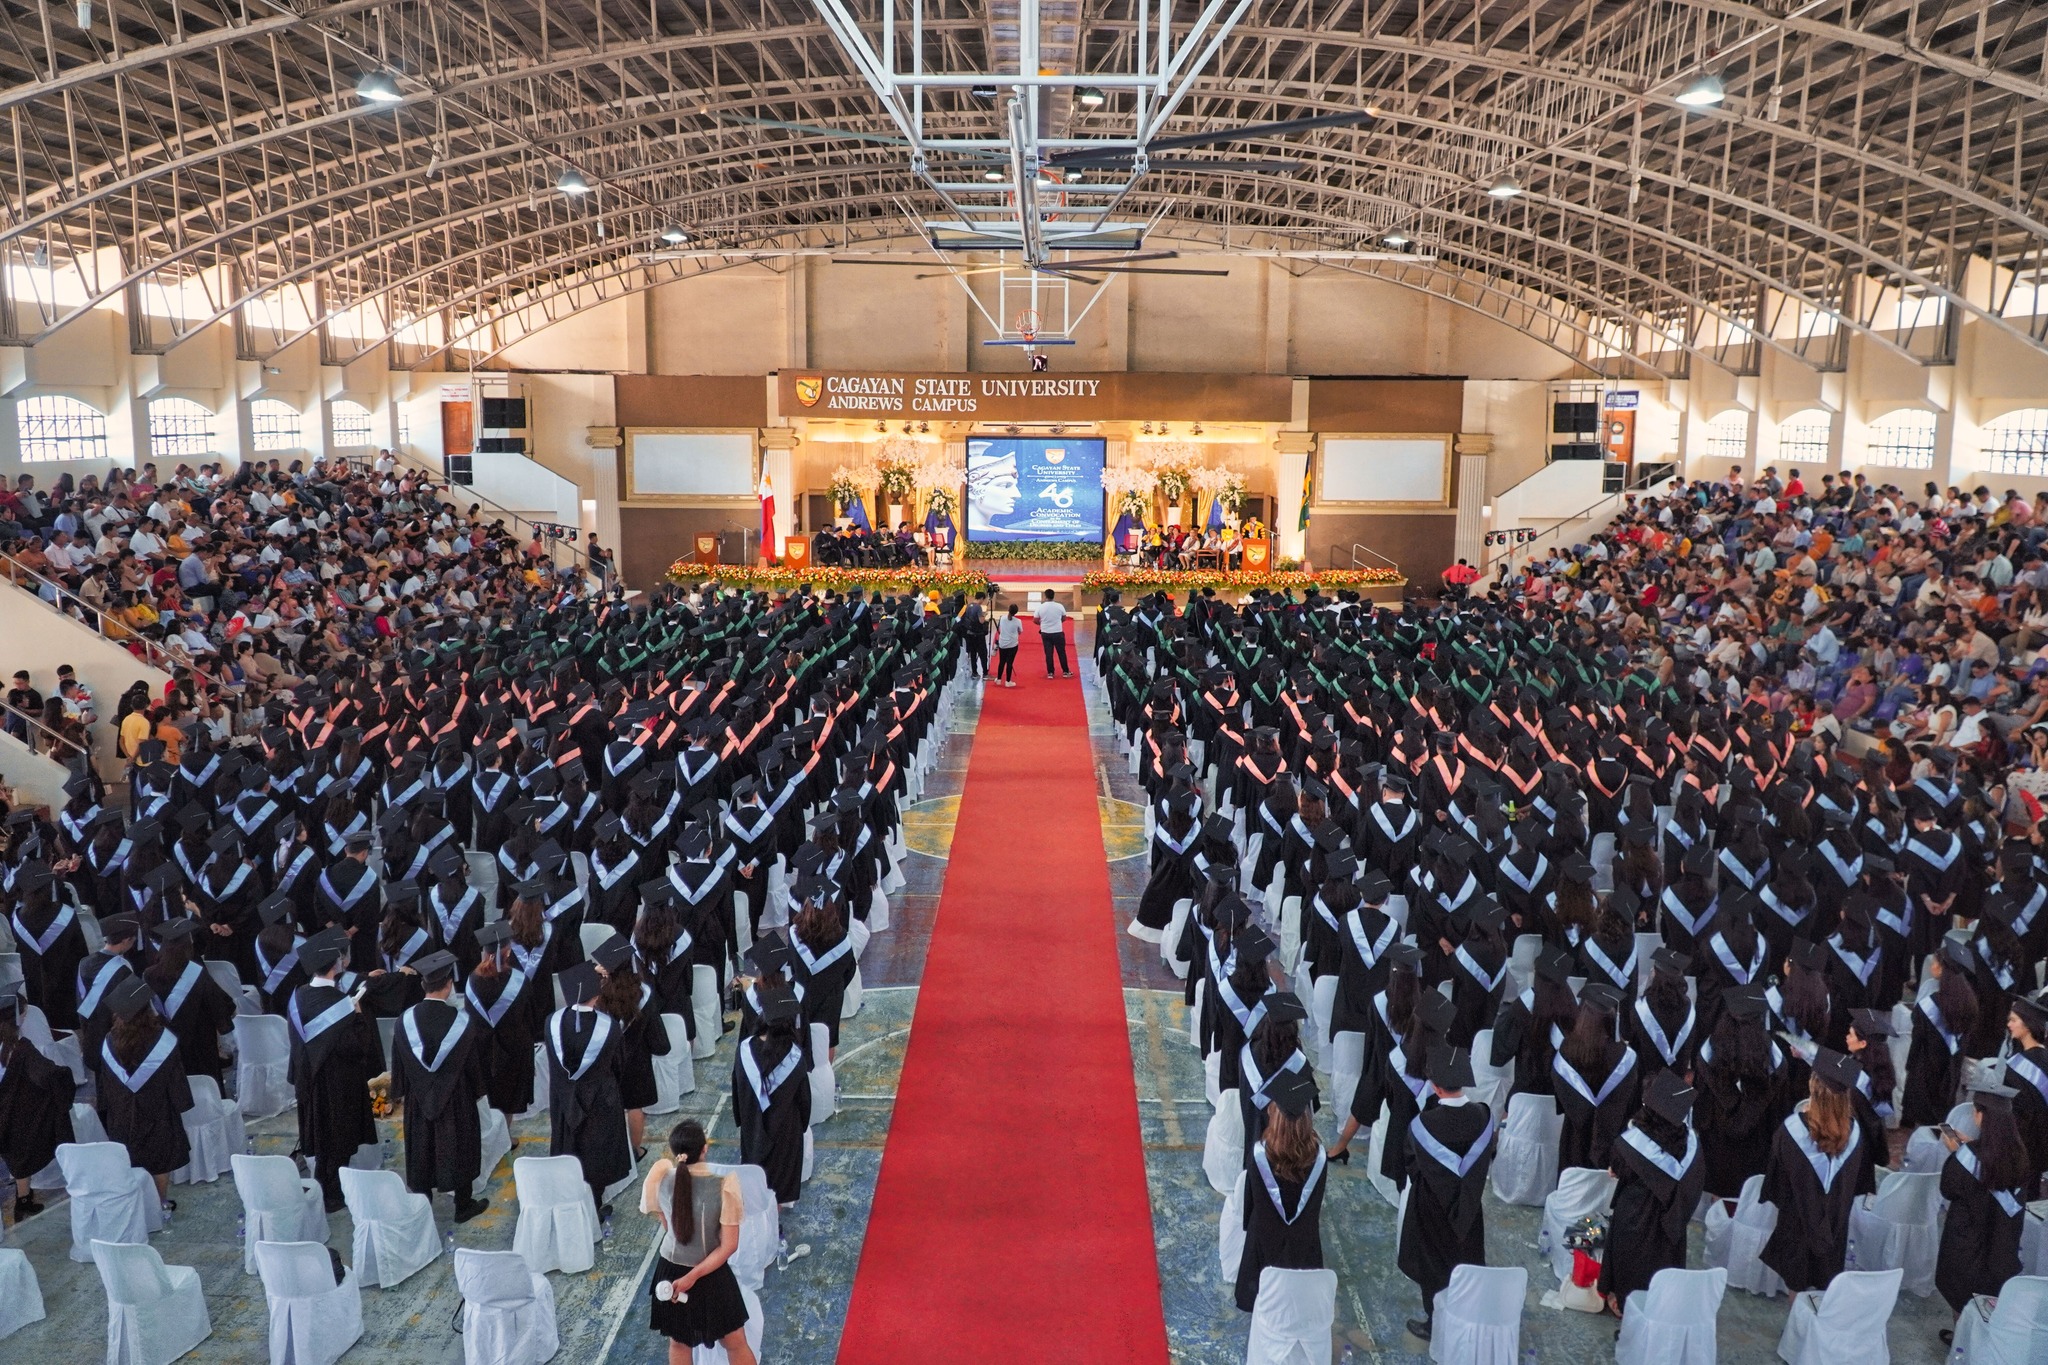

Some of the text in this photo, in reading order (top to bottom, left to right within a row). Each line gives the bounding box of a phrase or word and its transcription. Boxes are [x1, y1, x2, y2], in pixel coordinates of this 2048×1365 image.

[827, 377, 1100, 397] CAGAYAN STATE UNIVERSITY
[827, 396, 977, 412] ANDREWS CAMPUS
[1038, 482, 1074, 508] 46
